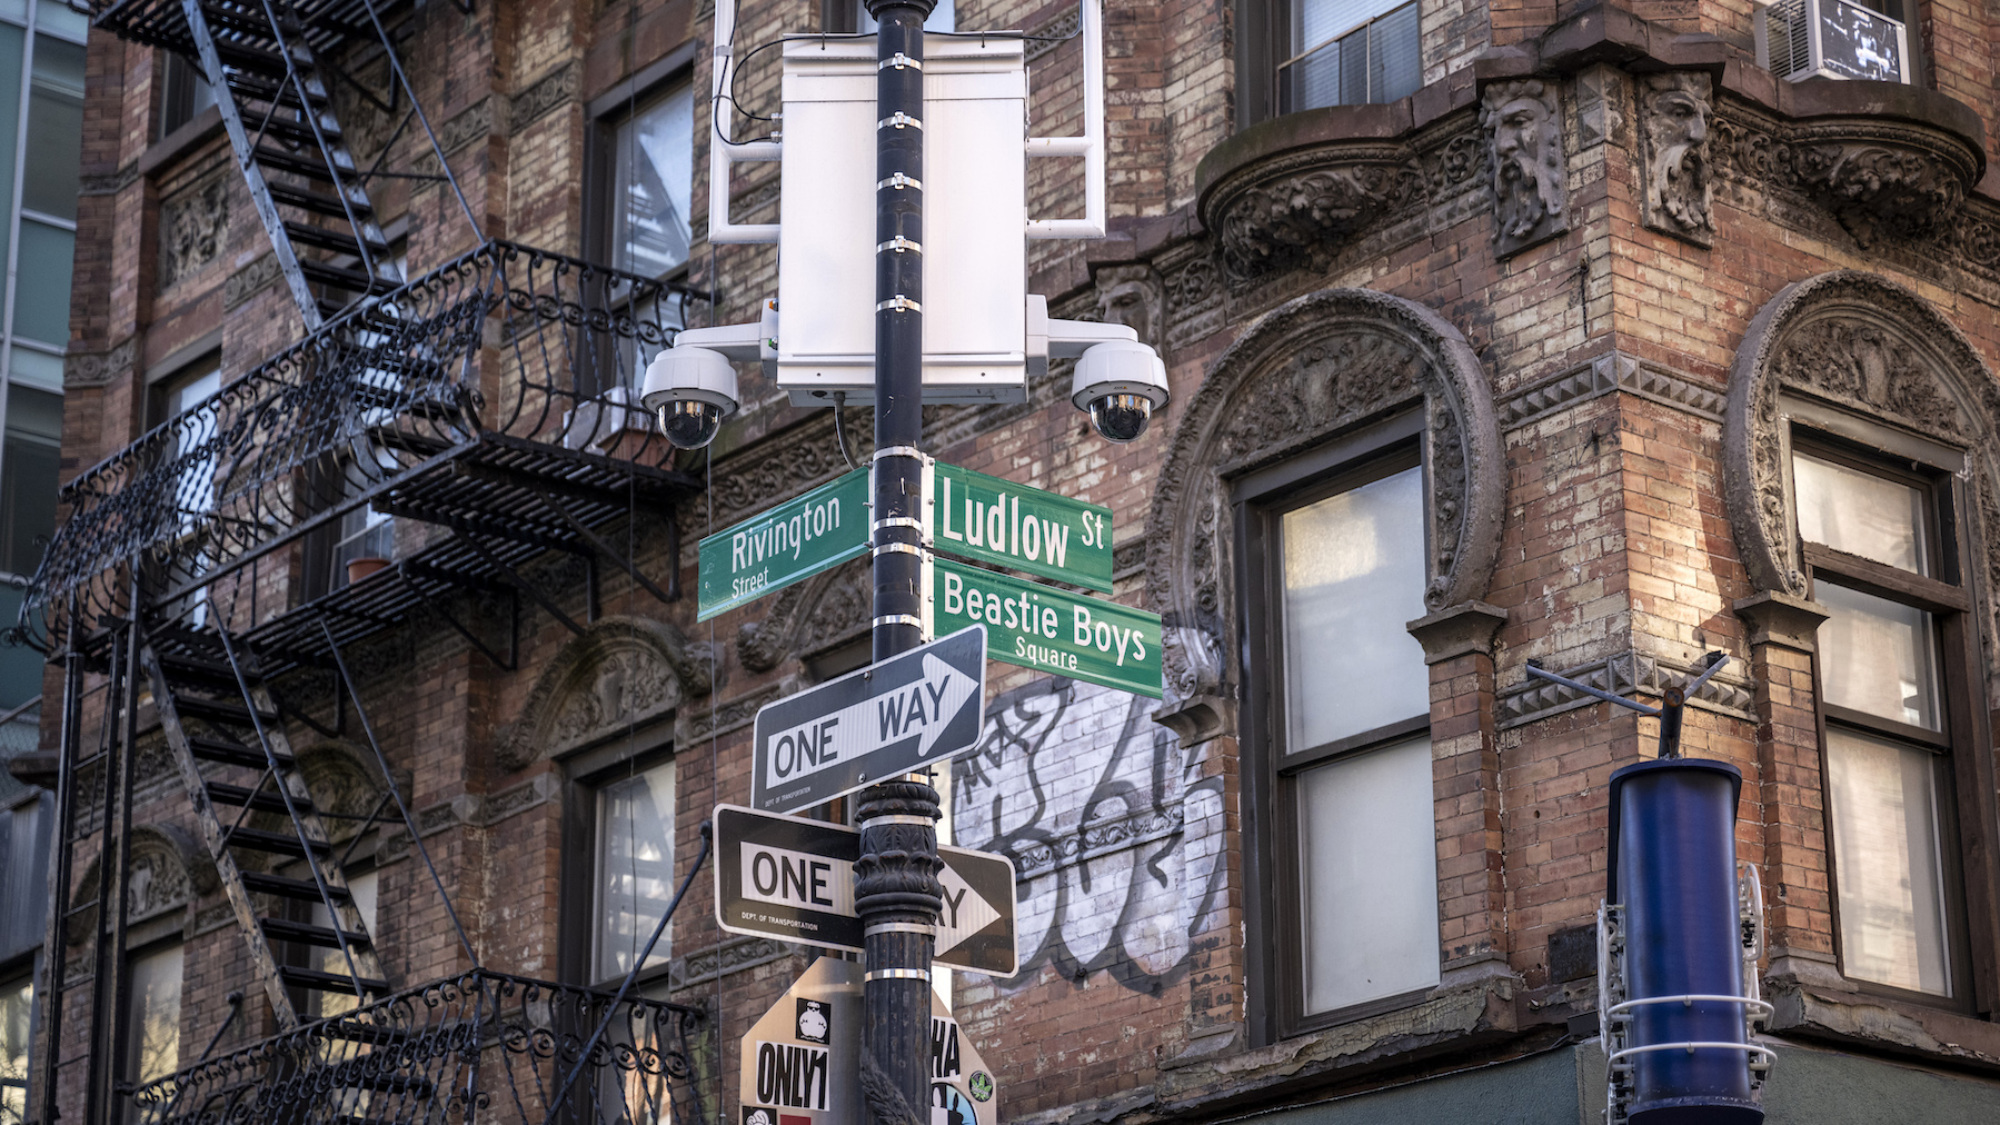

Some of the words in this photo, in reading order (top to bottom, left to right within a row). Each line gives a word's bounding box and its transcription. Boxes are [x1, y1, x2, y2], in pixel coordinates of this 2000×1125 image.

[731, 496, 841, 574] Rivington
[942, 477, 1069, 568] Ludlow
[1081, 509, 1104, 550] St
[731, 566, 769, 599] Street
[943, 571, 1058, 639] Beastie
[1073, 610, 1147, 667] Boys
[1015, 636, 1078, 671] Square
[774, 717, 839, 778] ONE
[878, 674, 951, 742] WAY
[752, 851, 833, 907] ONE
[741, 911, 758, 921] DEPT.
[759, 914, 767, 922] OF
[768, 916, 819, 931] TRANSPORTATION
[758, 1042, 828, 1110] ONLY1
